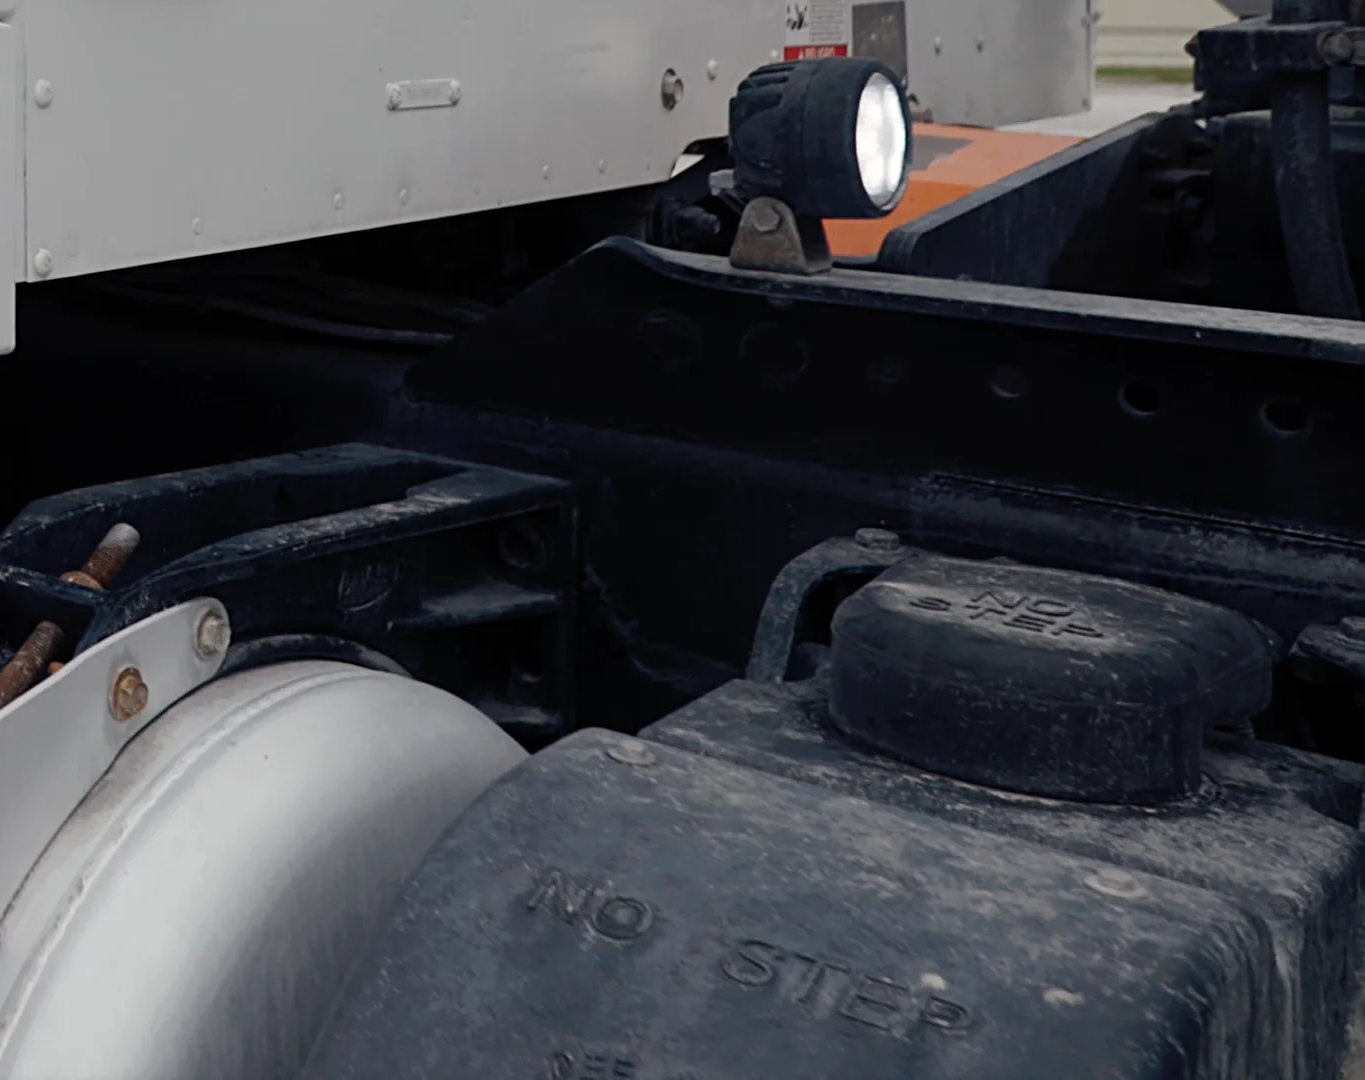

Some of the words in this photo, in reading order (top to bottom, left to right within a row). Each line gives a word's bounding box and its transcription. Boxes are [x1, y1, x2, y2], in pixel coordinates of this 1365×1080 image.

[909, 595, 1105, 640] STEP
[969, 591, 1077, 618] NO
[525, 868, 653, 943] NO
[721, 937, 975, 1038] STEP
